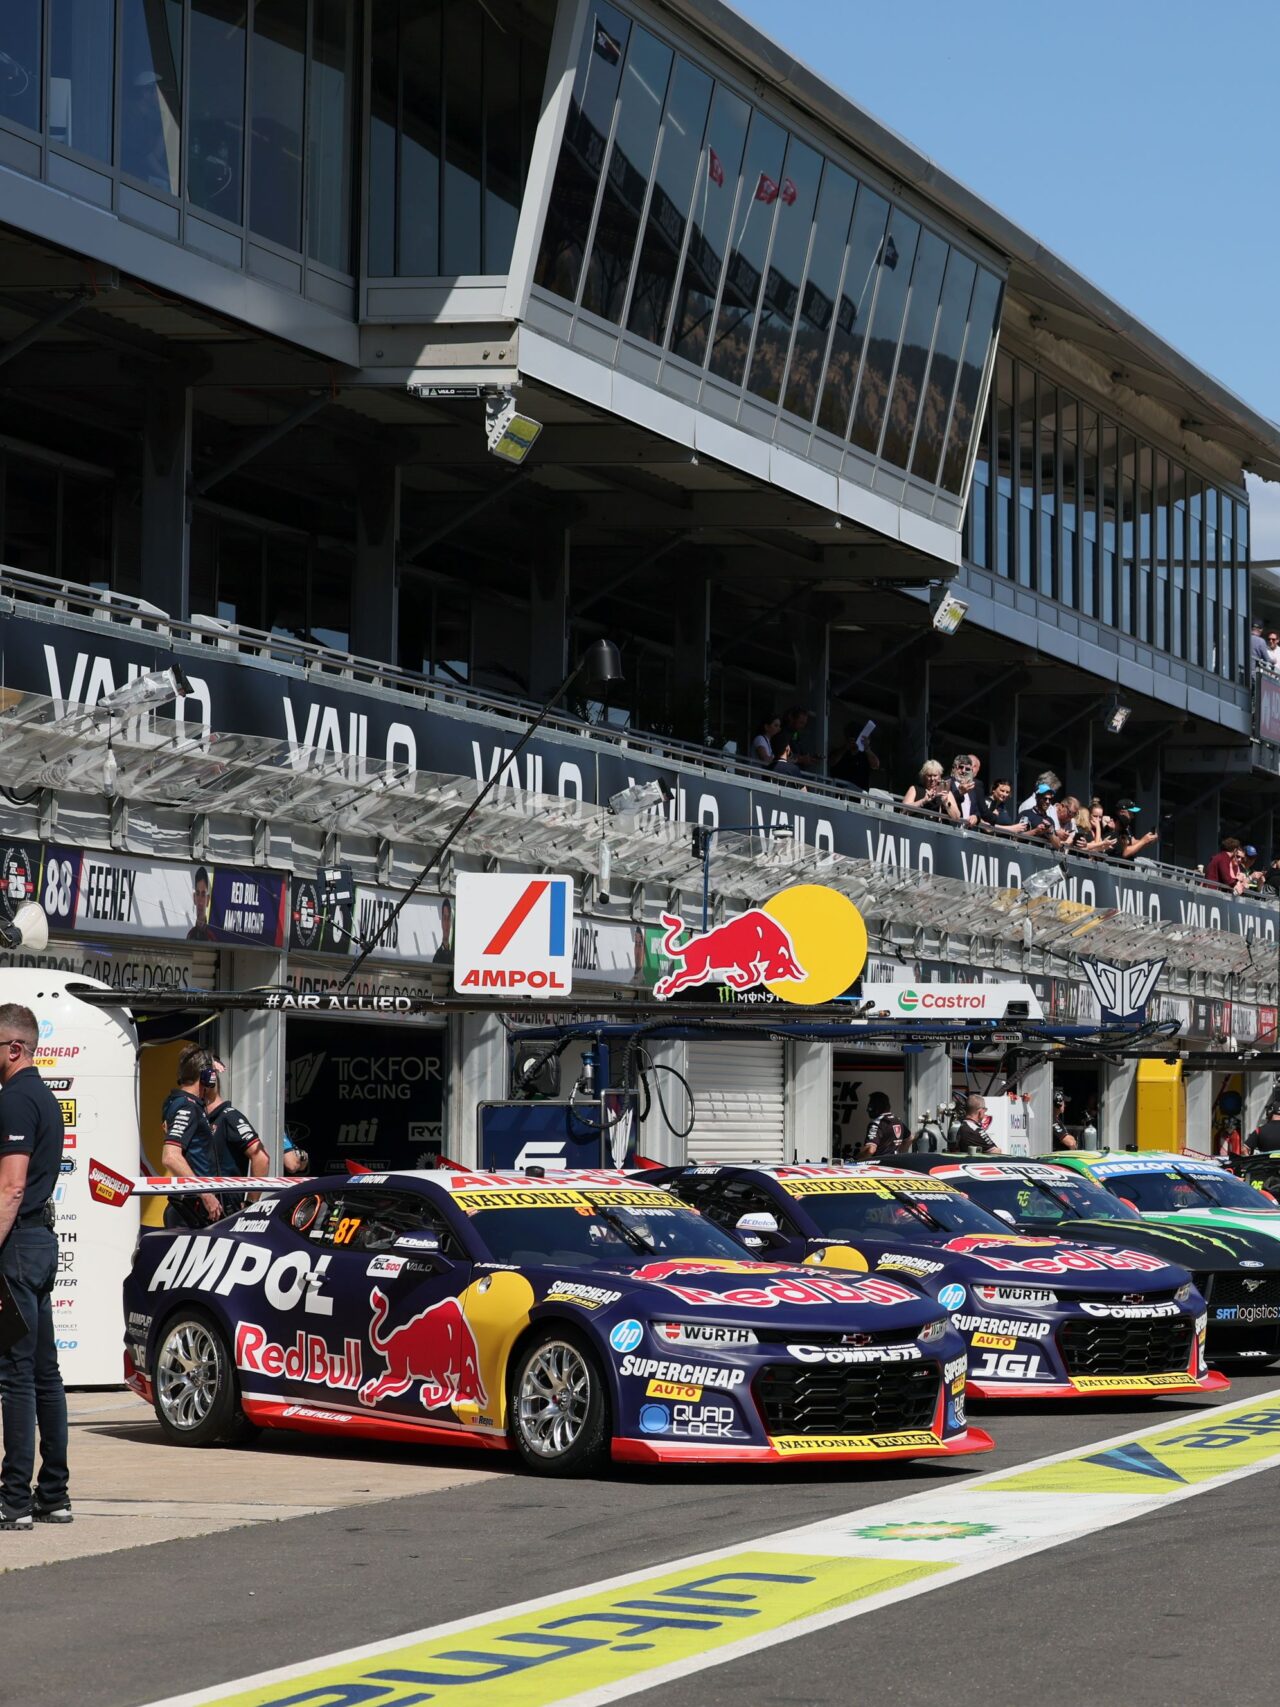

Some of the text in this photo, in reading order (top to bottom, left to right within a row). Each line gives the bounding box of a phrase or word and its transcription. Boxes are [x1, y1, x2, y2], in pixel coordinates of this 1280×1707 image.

[283, 696, 417, 786] VAILO
[471, 741, 583, 820] VAILO
[628, 777, 720, 852] AILO
[866, 830, 934, 876] VAILO
[961, 852, 1022, 893] VAILO
[45, 858, 73, 917] 88
[86, 865, 137, 922] FEENEY
[1115, 886, 1160, 921] VAILO
[360, 897, 400, 950] WATERS
[572, 927, 598, 970] ANDLE
[461, 969, 565, 989] AMPOL
[329, 996, 412, 1011] ALLIED
[738, 992, 786, 1003] MONST
[921, 993, 985, 1009] Castrol
[32, 1046, 80, 1058] ERCHEAP
[331, 1057, 442, 1081] TICKFOR
[338, 1084, 411, 1099] RACING
[361, 1175, 390, 1184] BROWN
[694, 1167, 722, 1175] FEENEY
[1001, 1165, 1055, 1176] ENZED
[89, 1167, 130, 1196] SUPERCHEAP
[783, 1181, 880, 1193] NATIONAL
[97, 1185, 113, 1198] AUTO
[460, 1191, 683, 1208] NATIONAL STORAGE
[625, 1206, 676, 1217] Brown
[229, 1217, 270, 1233] Norman
[333, 1218, 361, 1244] 87
[741, 1218, 776, 1227] ACDelco
[397, 1236, 439, 1248] ACDelco
[405, 1262, 432, 1272] VAILO
[878, 1253, 945, 1274] SUPERCHEAP
[147, 1235, 334, 1316] AMPOL
[547, 1280, 622, 1304] SUPERCHEAP
[999, 1287, 1050, 1301] WÜRTH
[1079, 1302, 1181, 1319] COMPLETE
[684, 1325, 750, 1343] WÜRTH
[951, 1313, 1050, 1340] SUPERCHEAP
[976, 1336, 1011, 1346] AUTO
[786, 1344, 922, 1364] COMPLETE
[619, 1354, 745, 1390] SUPERCHEAP
[971, 1353, 1041, 1378] JGI
[652, 1384, 696, 1398] AUTO
[1078, 1378, 1146, 1388] NATIONAL
[673, 1404, 734, 1423] QUAD
[672, 1420, 733, 1437] LOCK
[780, 1433, 941, 1449] NATIONAL STORAGE
[258, 1572, 816, 1707] ultim
